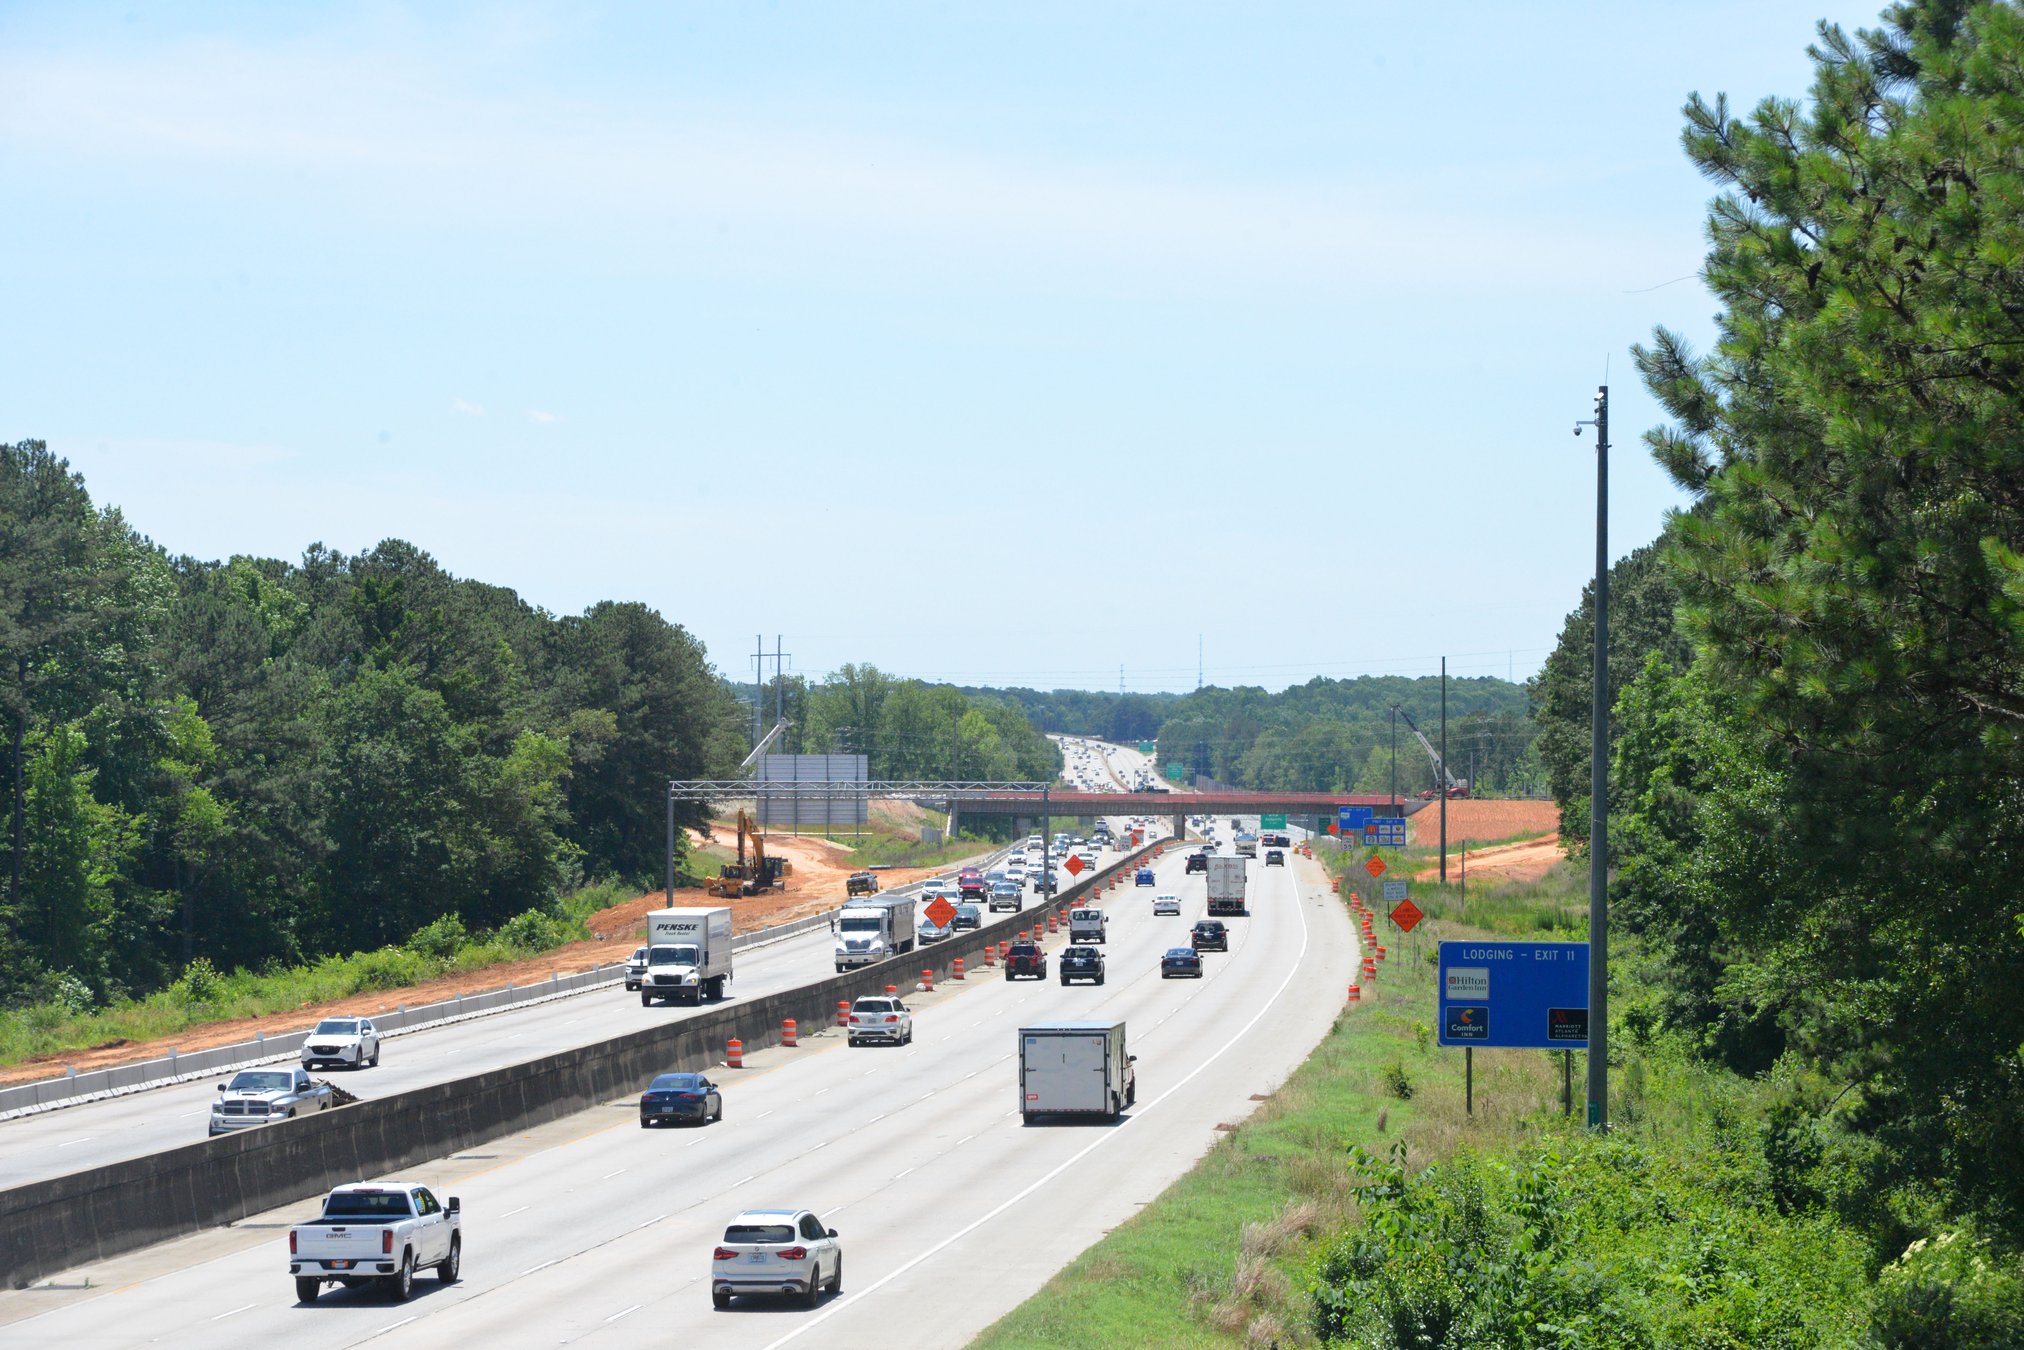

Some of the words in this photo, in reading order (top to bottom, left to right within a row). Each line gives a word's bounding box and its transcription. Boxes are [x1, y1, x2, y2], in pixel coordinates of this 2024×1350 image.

[1463, 950, 1513, 960] LODGING
[1535, 950, 1558, 960] EXIT
[1567, 951, 1574, 961] 11
